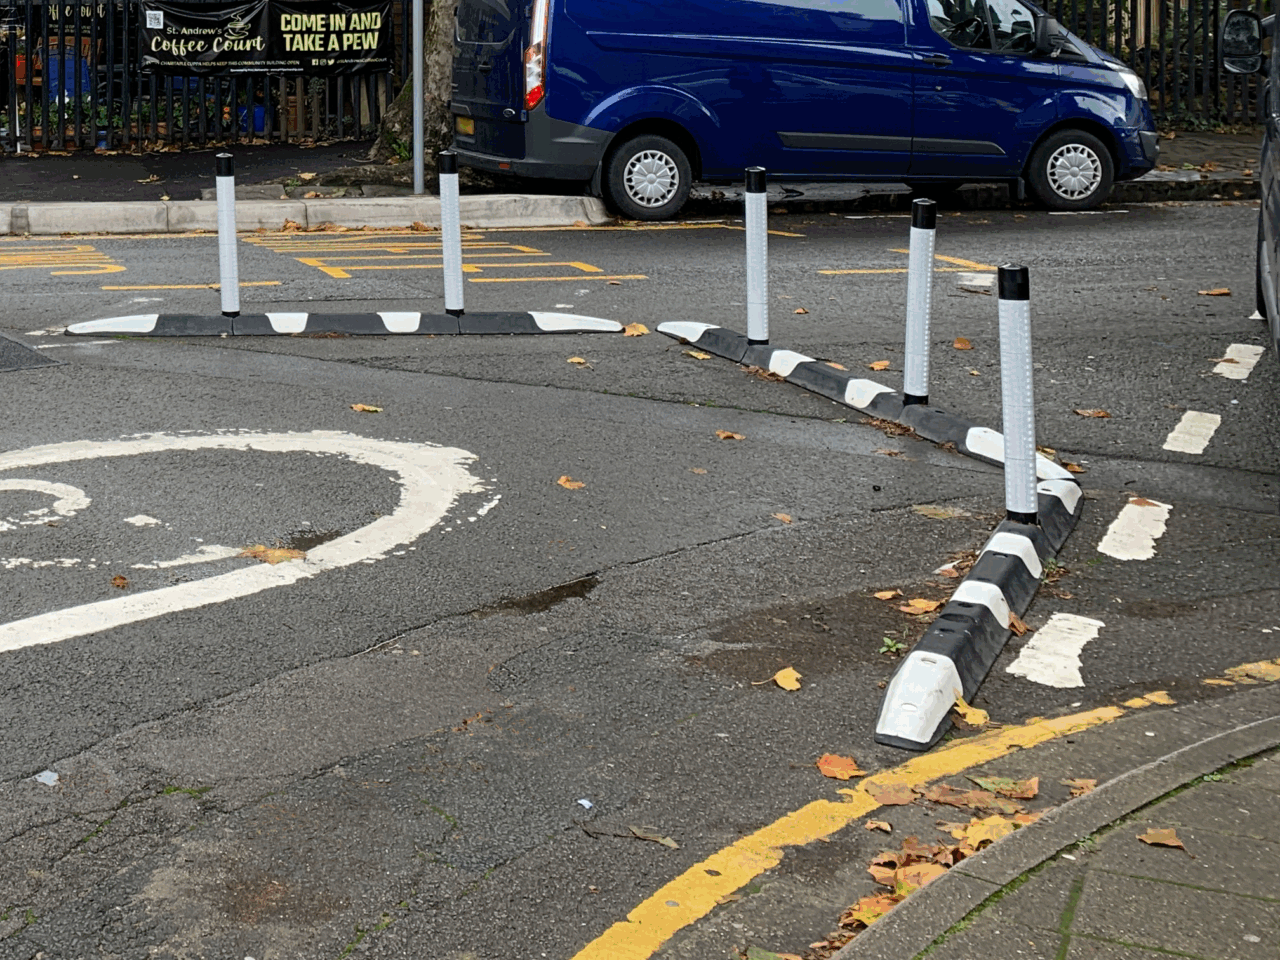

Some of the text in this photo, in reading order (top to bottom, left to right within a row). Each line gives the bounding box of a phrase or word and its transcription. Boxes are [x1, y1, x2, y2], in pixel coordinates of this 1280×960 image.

[166, 26, 222, 35] St. Andrew's
[280, 12, 382, 31] COME IN AND
[151, 36, 266, 56] Coffee Court
[283, 32, 379, 51] TAKE A PEW
